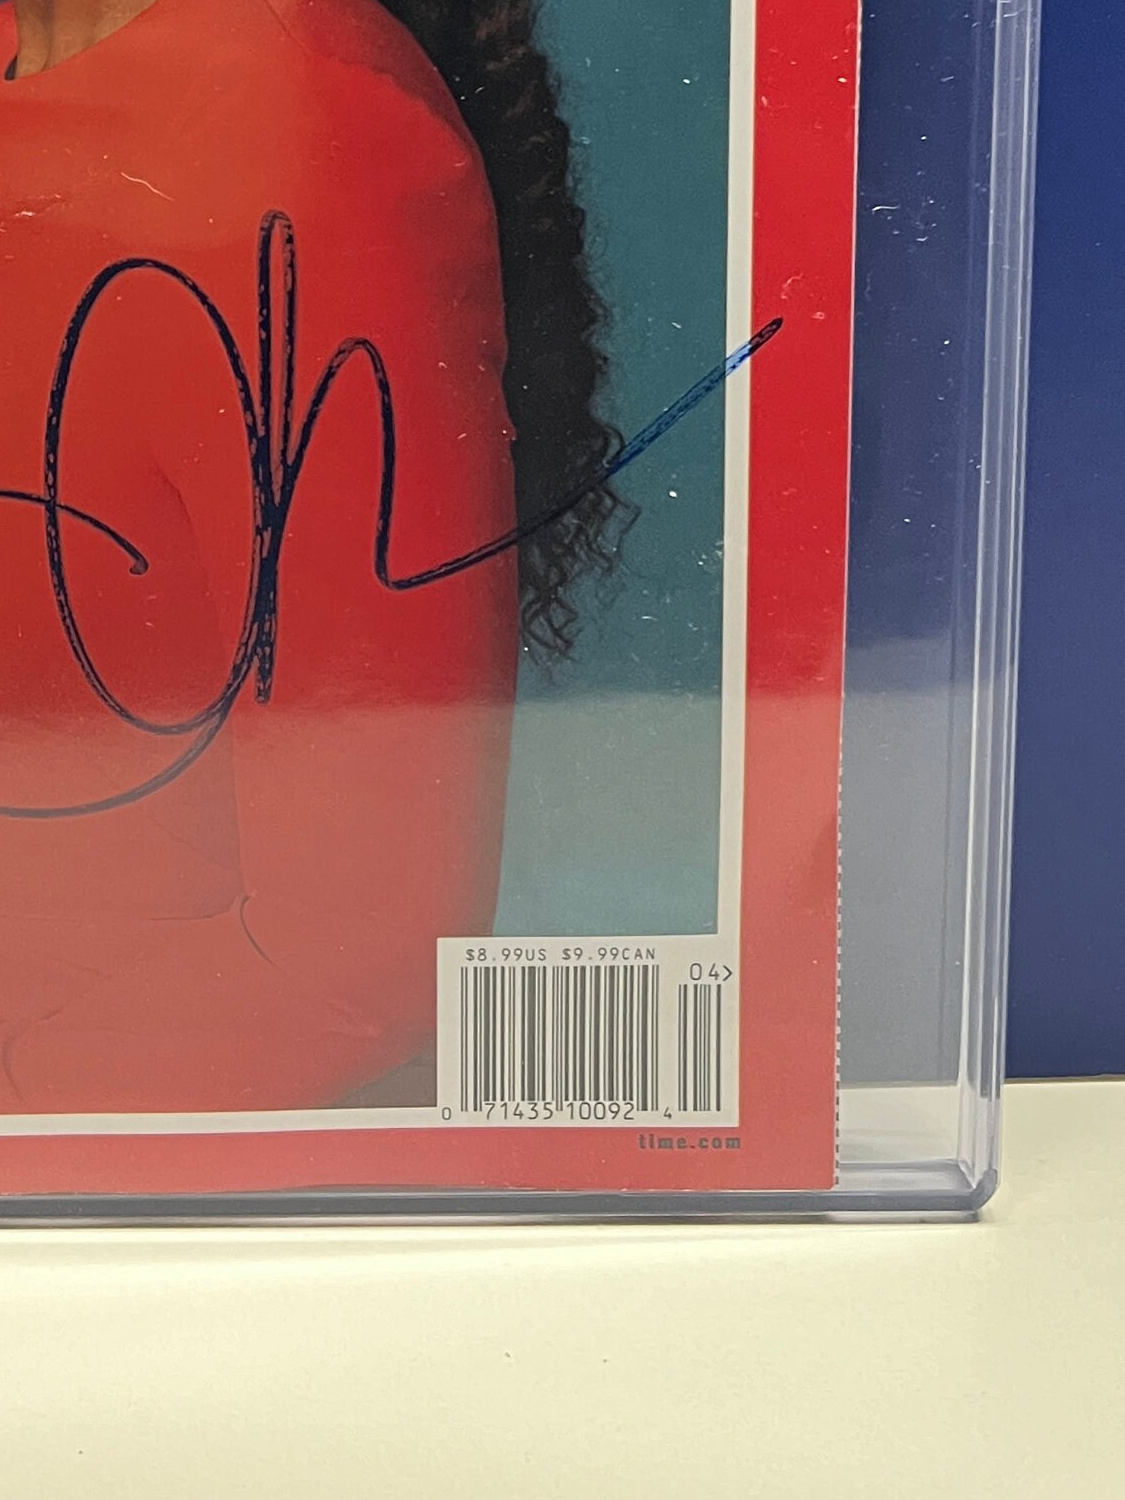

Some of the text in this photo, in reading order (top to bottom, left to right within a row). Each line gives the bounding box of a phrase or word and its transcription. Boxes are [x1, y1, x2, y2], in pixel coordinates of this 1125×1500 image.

[465, 947, 657, 962] $8.99US $9.99CAN
[441, 1101, 673, 1121] 0 71435 10092 4
[637, 1132, 742, 1150] time.com
